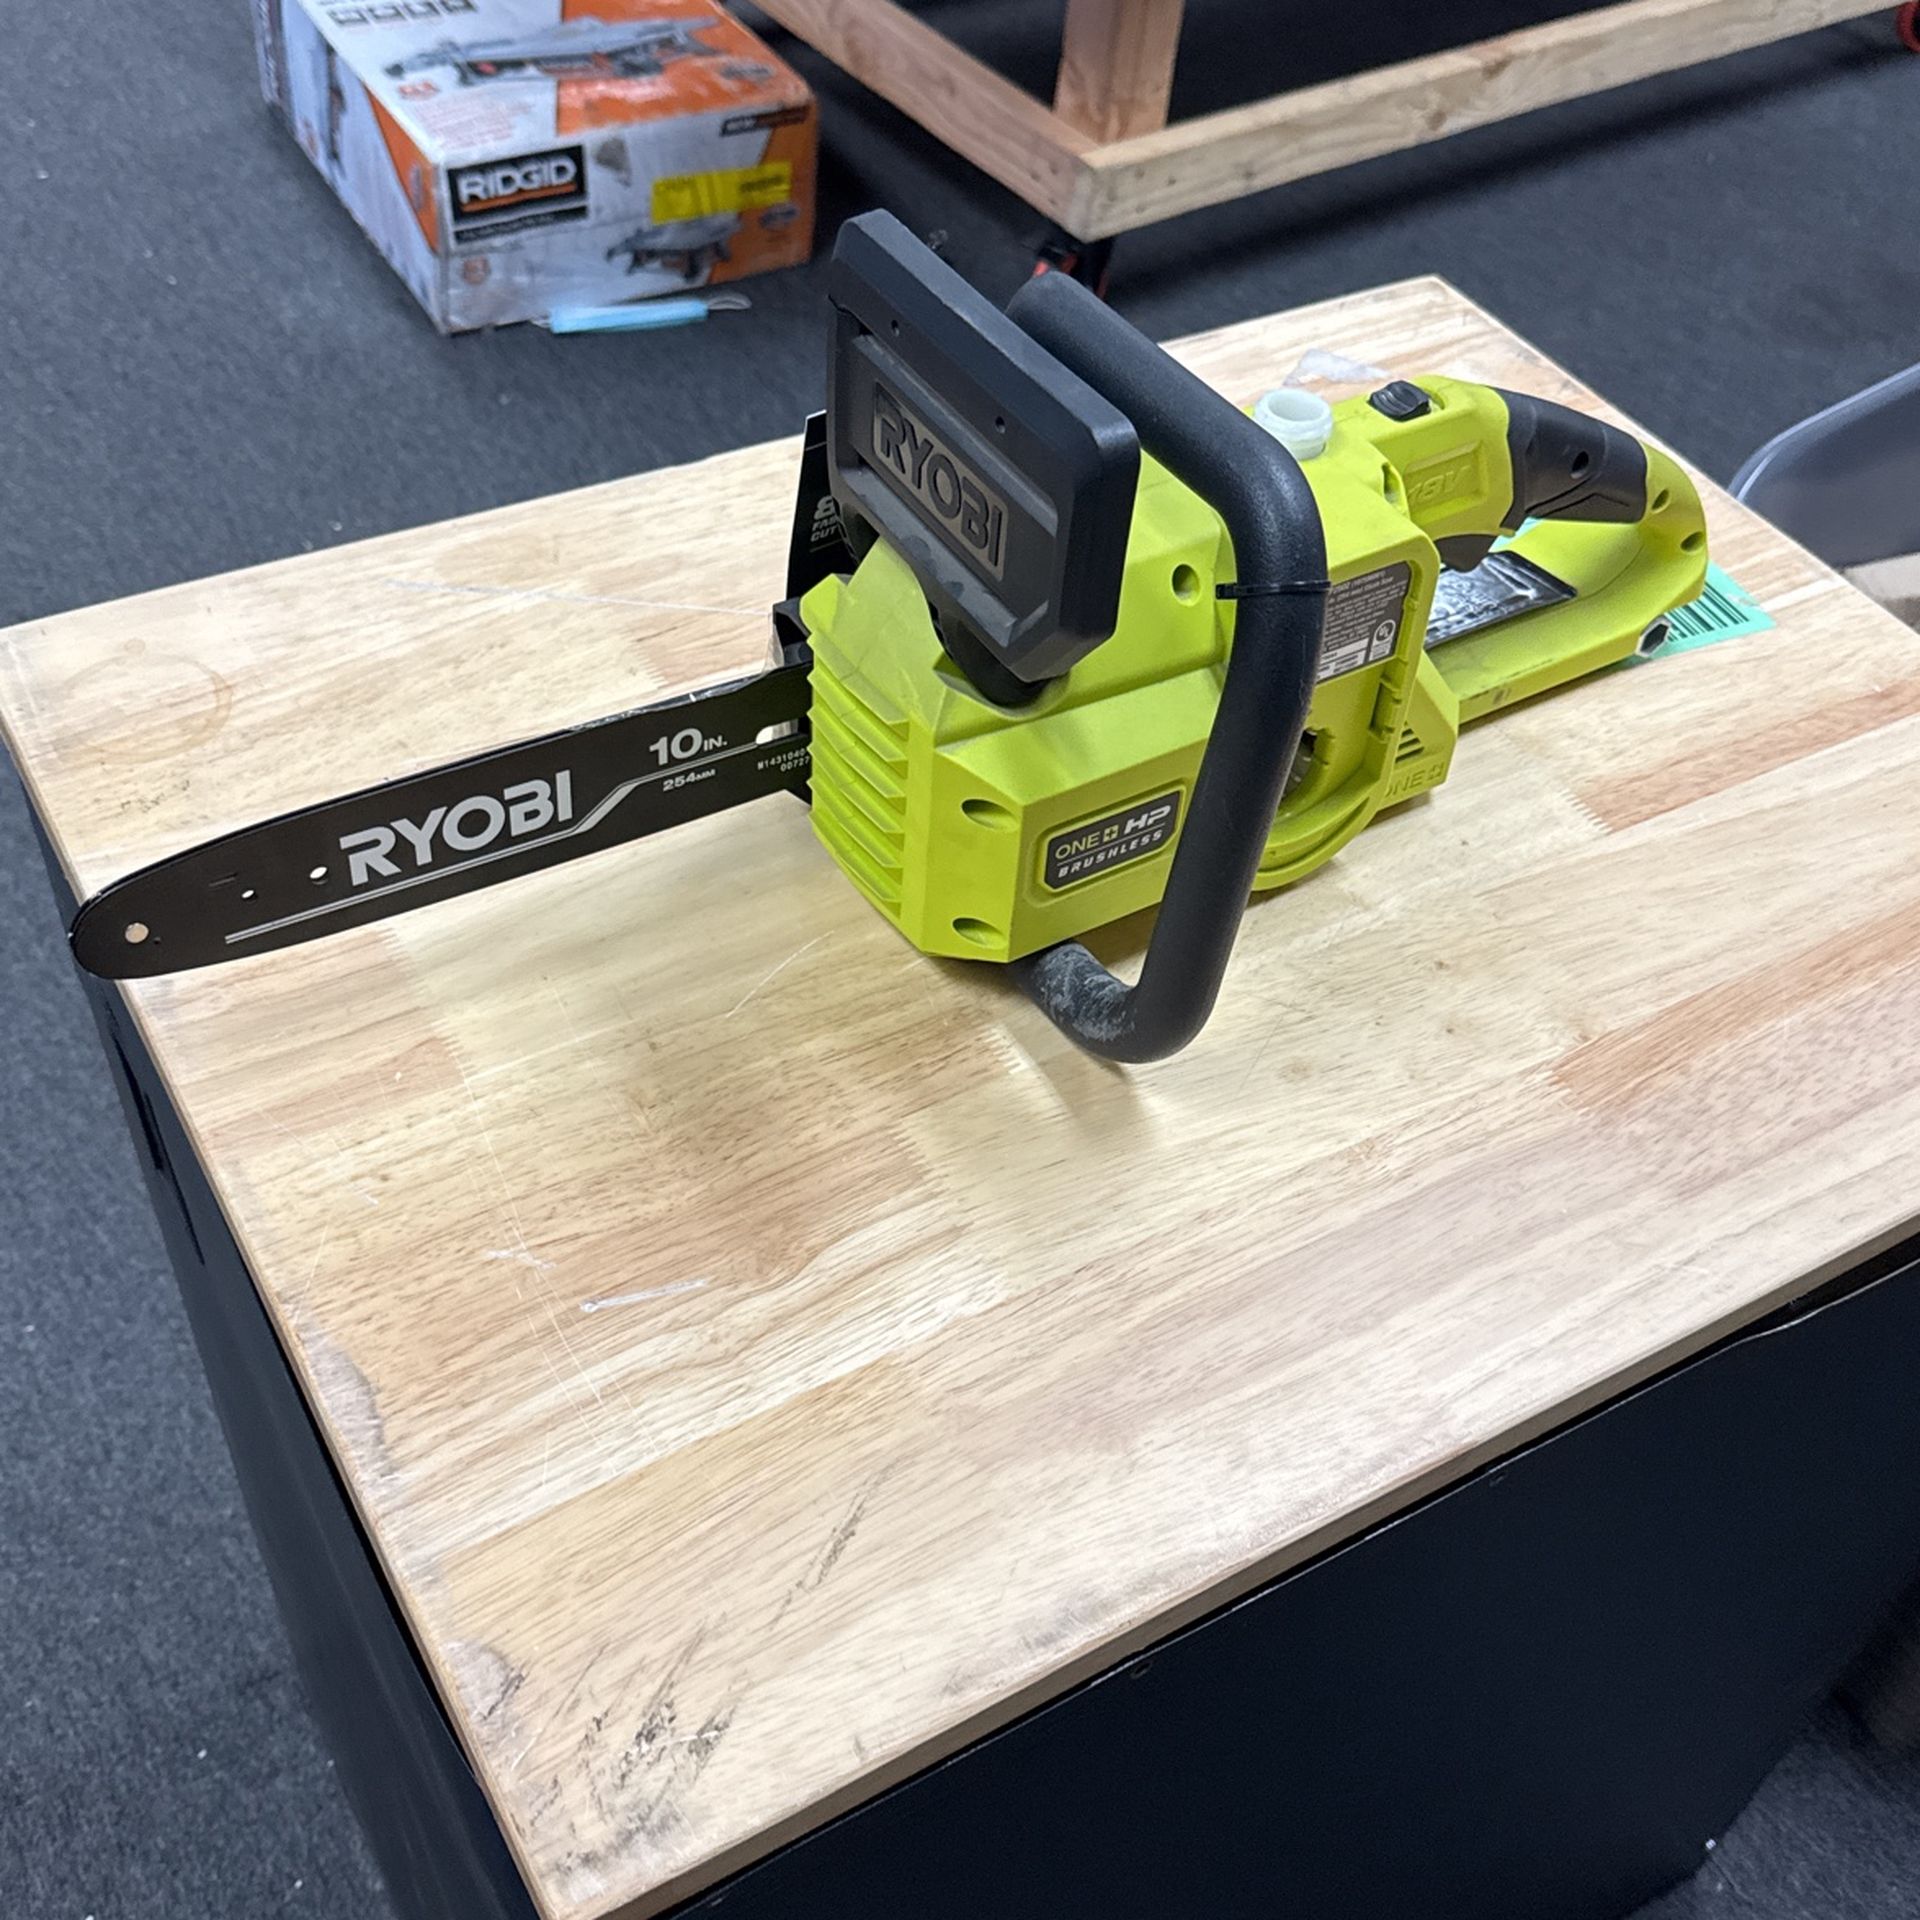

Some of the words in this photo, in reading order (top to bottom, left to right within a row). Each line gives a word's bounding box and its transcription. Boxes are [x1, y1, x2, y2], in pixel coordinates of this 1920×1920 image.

[457, 155, 577, 204] RIDGID
[876, 382, 1004, 567] RYOBI
[339, 769, 573, 887] RYOBI
[1123, 805, 1171, 835] HP
[1058, 829, 1163, 878] BRUSHLESS
